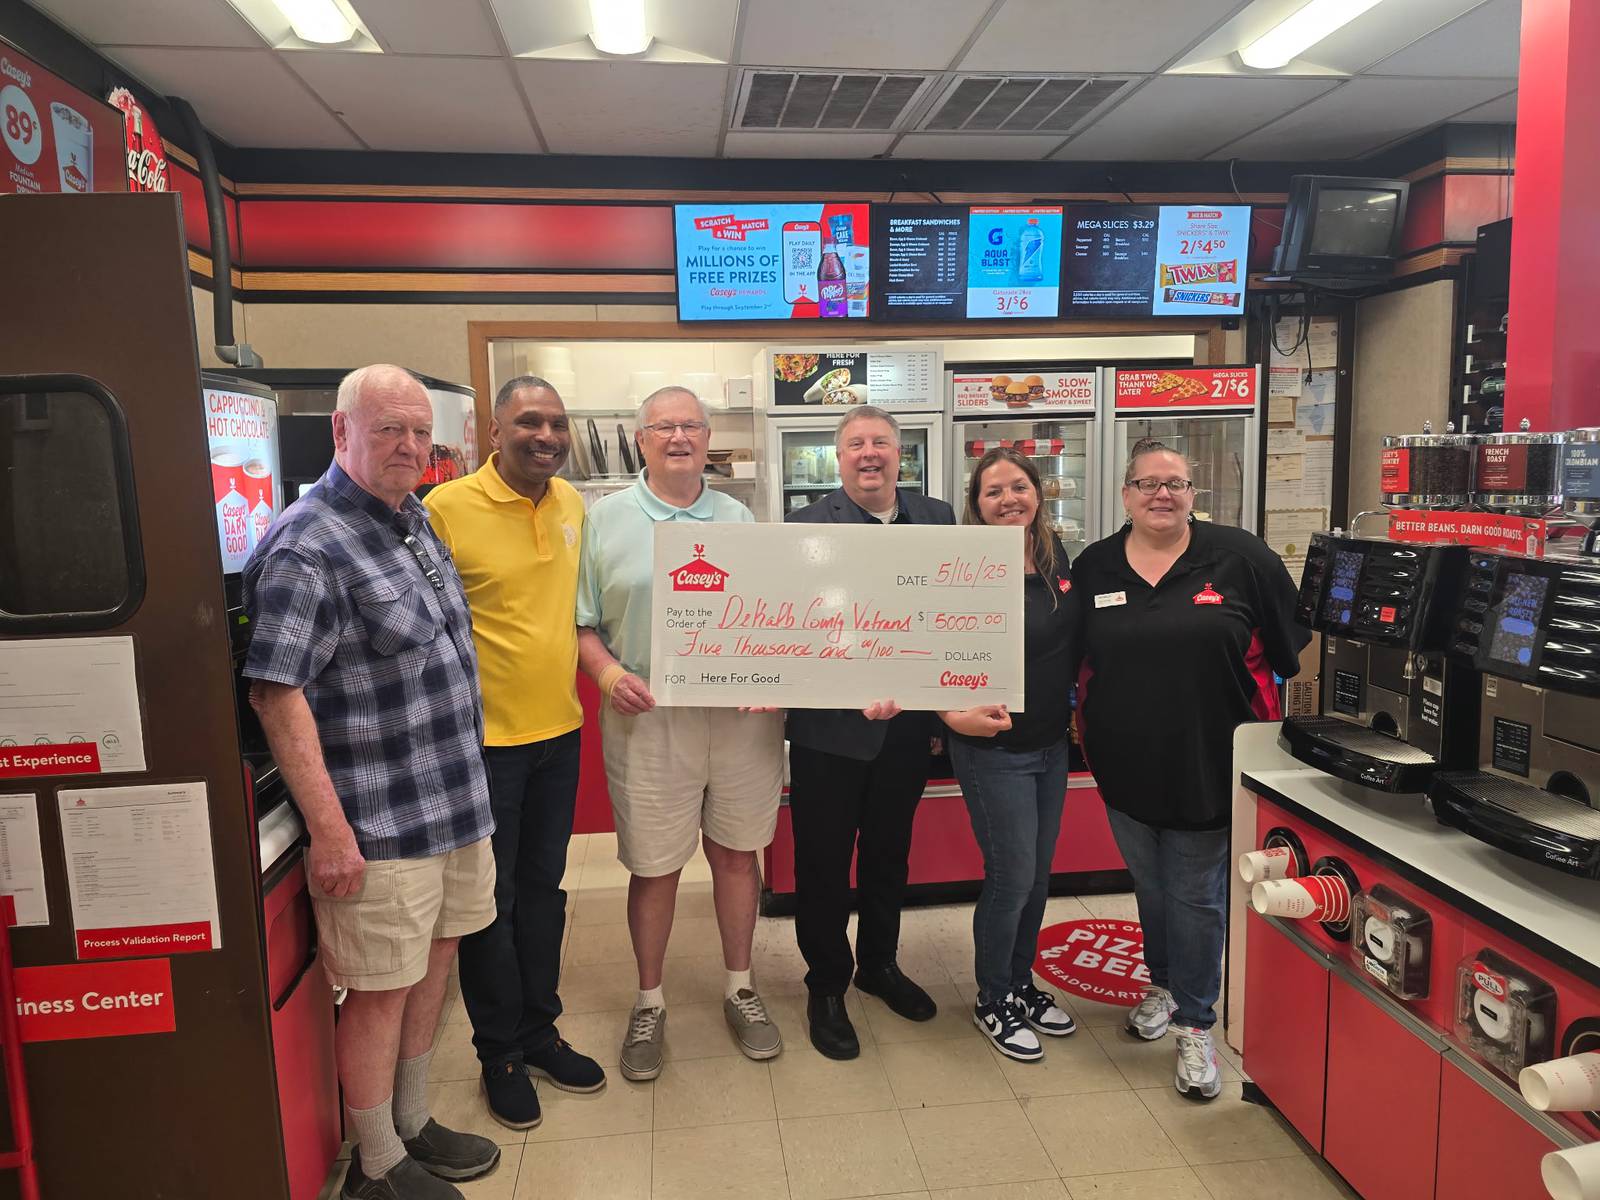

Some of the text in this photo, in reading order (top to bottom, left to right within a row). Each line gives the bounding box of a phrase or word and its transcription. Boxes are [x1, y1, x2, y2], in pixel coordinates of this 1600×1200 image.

[1, 57, 32, 88] Casey's
[128, 149, 166, 192] a-Cola
[10, 171, 40, 190] FOUNTAIN
[700, 217, 731, 228] SCRATCH
[741, 221, 765, 230] MATCH
[1077, 220, 1155, 229] MEGA SLICES $3.29
[723, 230, 742, 239] WIN
[988, 228, 1003, 246] G
[686, 255, 779, 268] MILLIONS OF
[984, 249, 1008, 258] AQUA
[981, 259, 1010, 267] BLAST
[690, 271, 777, 284] FREE PRIZES
[1167, 263, 1216, 285] TWIX
[711, 287, 737, 298] Casey's
[1174, 291, 1211, 303] SNICKERS
[1058, 378, 1092, 387] SLOW-
[1211, 379, 1249, 398] 2/$6
[1045, 389, 1091, 398] SMOKED
[209, 393, 260, 417] CAPPUCCINO
[957, 399, 989, 407] SLIDERS
[208, 417, 270, 439] HOT CHOCOLATE
[1487, 455, 1506, 463] ROAST
[223, 503, 246, 521] Casey's
[224, 518, 247, 535] DARN
[1395, 521, 1523, 541] BETTER BEANS. DARN GOOD ROASTS.
[227, 535, 247, 553] GOOD
[677, 570, 722, 588] Casey's
[935, 556, 1008, 588] 5/16/25
[897, 575, 928, 586] DATE
[1196, 594, 1220, 603] Casey's
[666, 608, 712, 618] Pay to the
[918, 611, 925, 622] $
[666, 619, 707, 629] Order of
[675, 629, 722, 657] Five
[732, 635, 814, 657] Thousand
[945, 651, 992, 661] DOLLARS
[665, 674, 686, 684] FOR
[701, 672, 780, 683] Here For Good
[940, 671, 988, 690] Casey's
[13, 753, 92, 770] Experience
[83, 932, 206, 948] Process Validation Report
[1066, 928, 1145, 960] PIZ
[1072, 950, 1152, 983] BEE
[1045, 964, 1148, 1000] HEADQUARTE
[1478, 974, 1502, 993] PULL
[16, 991, 164, 1016] iness Center
